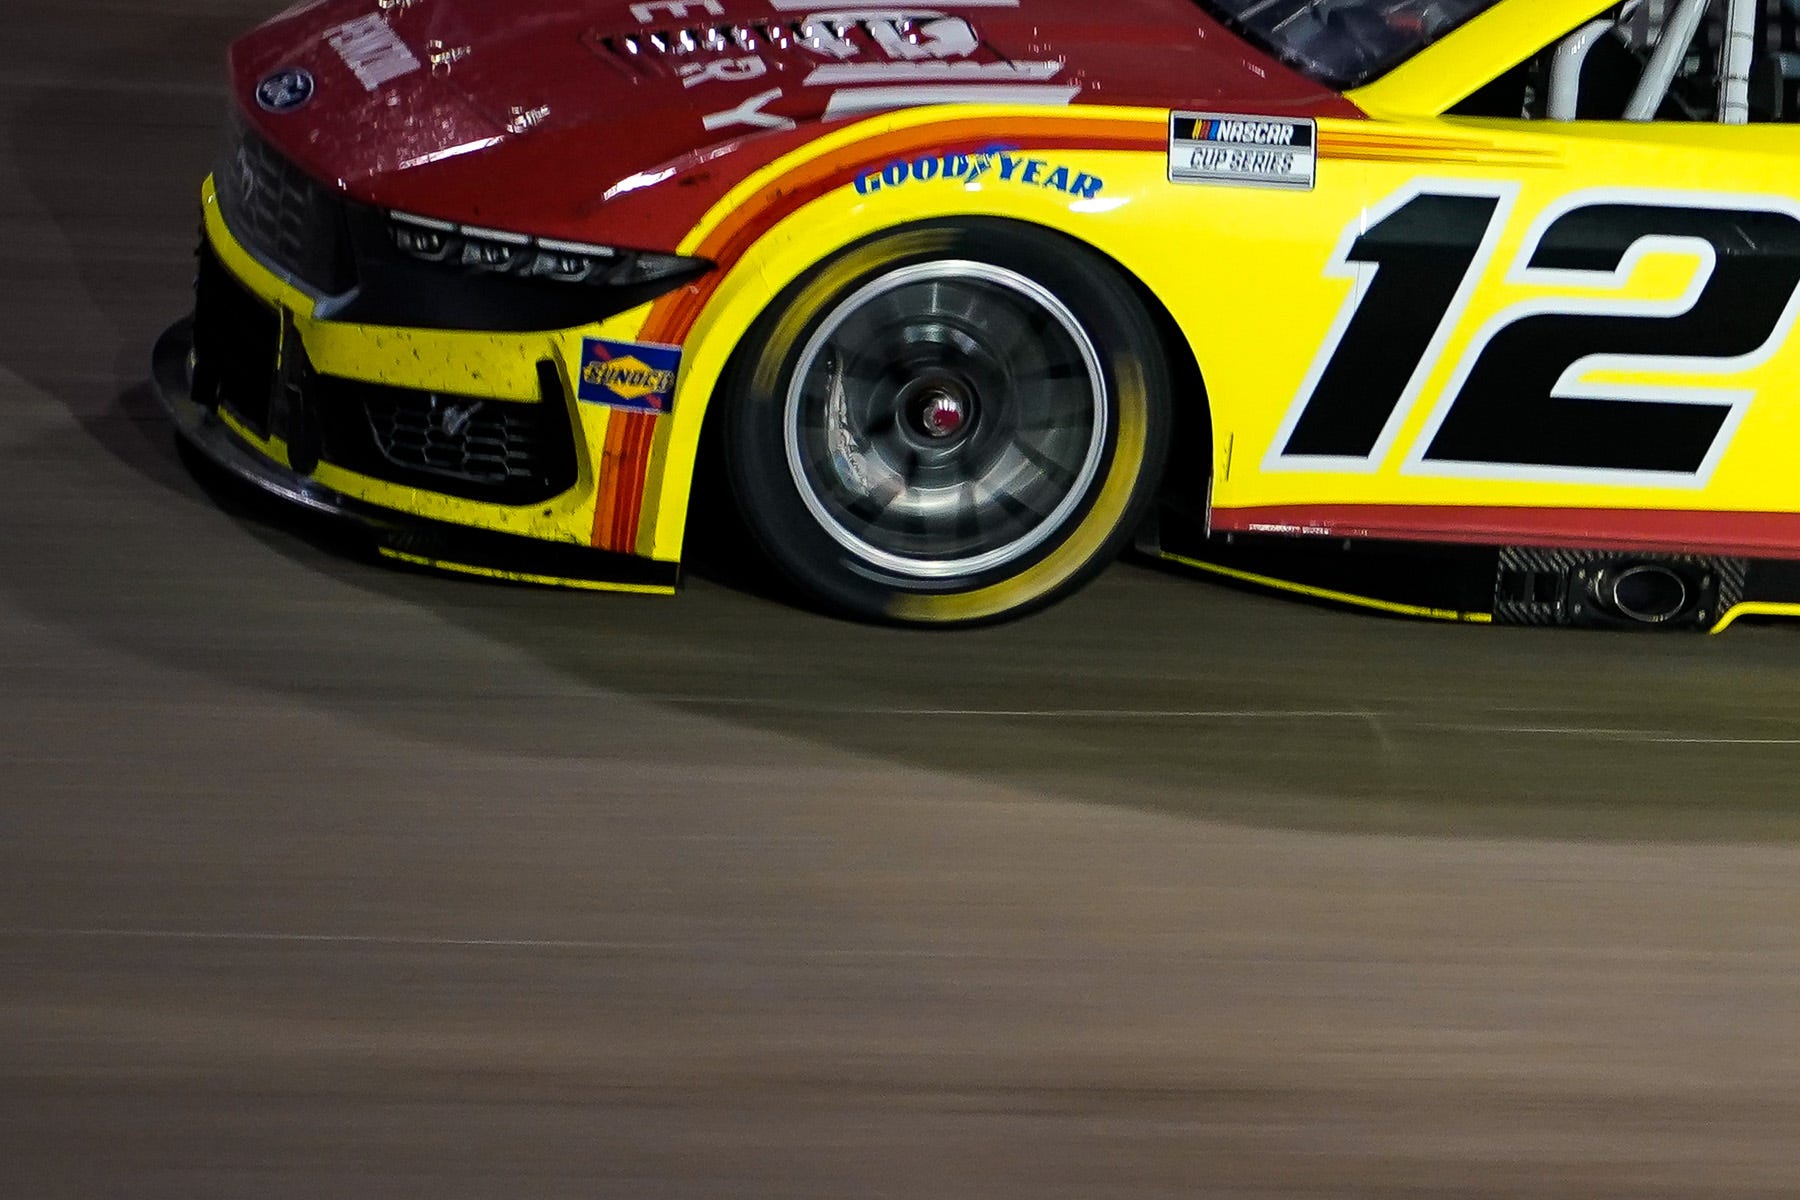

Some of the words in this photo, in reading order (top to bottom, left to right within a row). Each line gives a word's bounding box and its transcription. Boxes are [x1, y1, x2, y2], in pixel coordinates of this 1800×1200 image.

[1216, 120, 1294, 146] NASCAR
[853, 150, 1104, 199] GOODYEAR
[1190, 147, 1228, 171] CUP
[1228, 150, 1294, 175] SERIES
